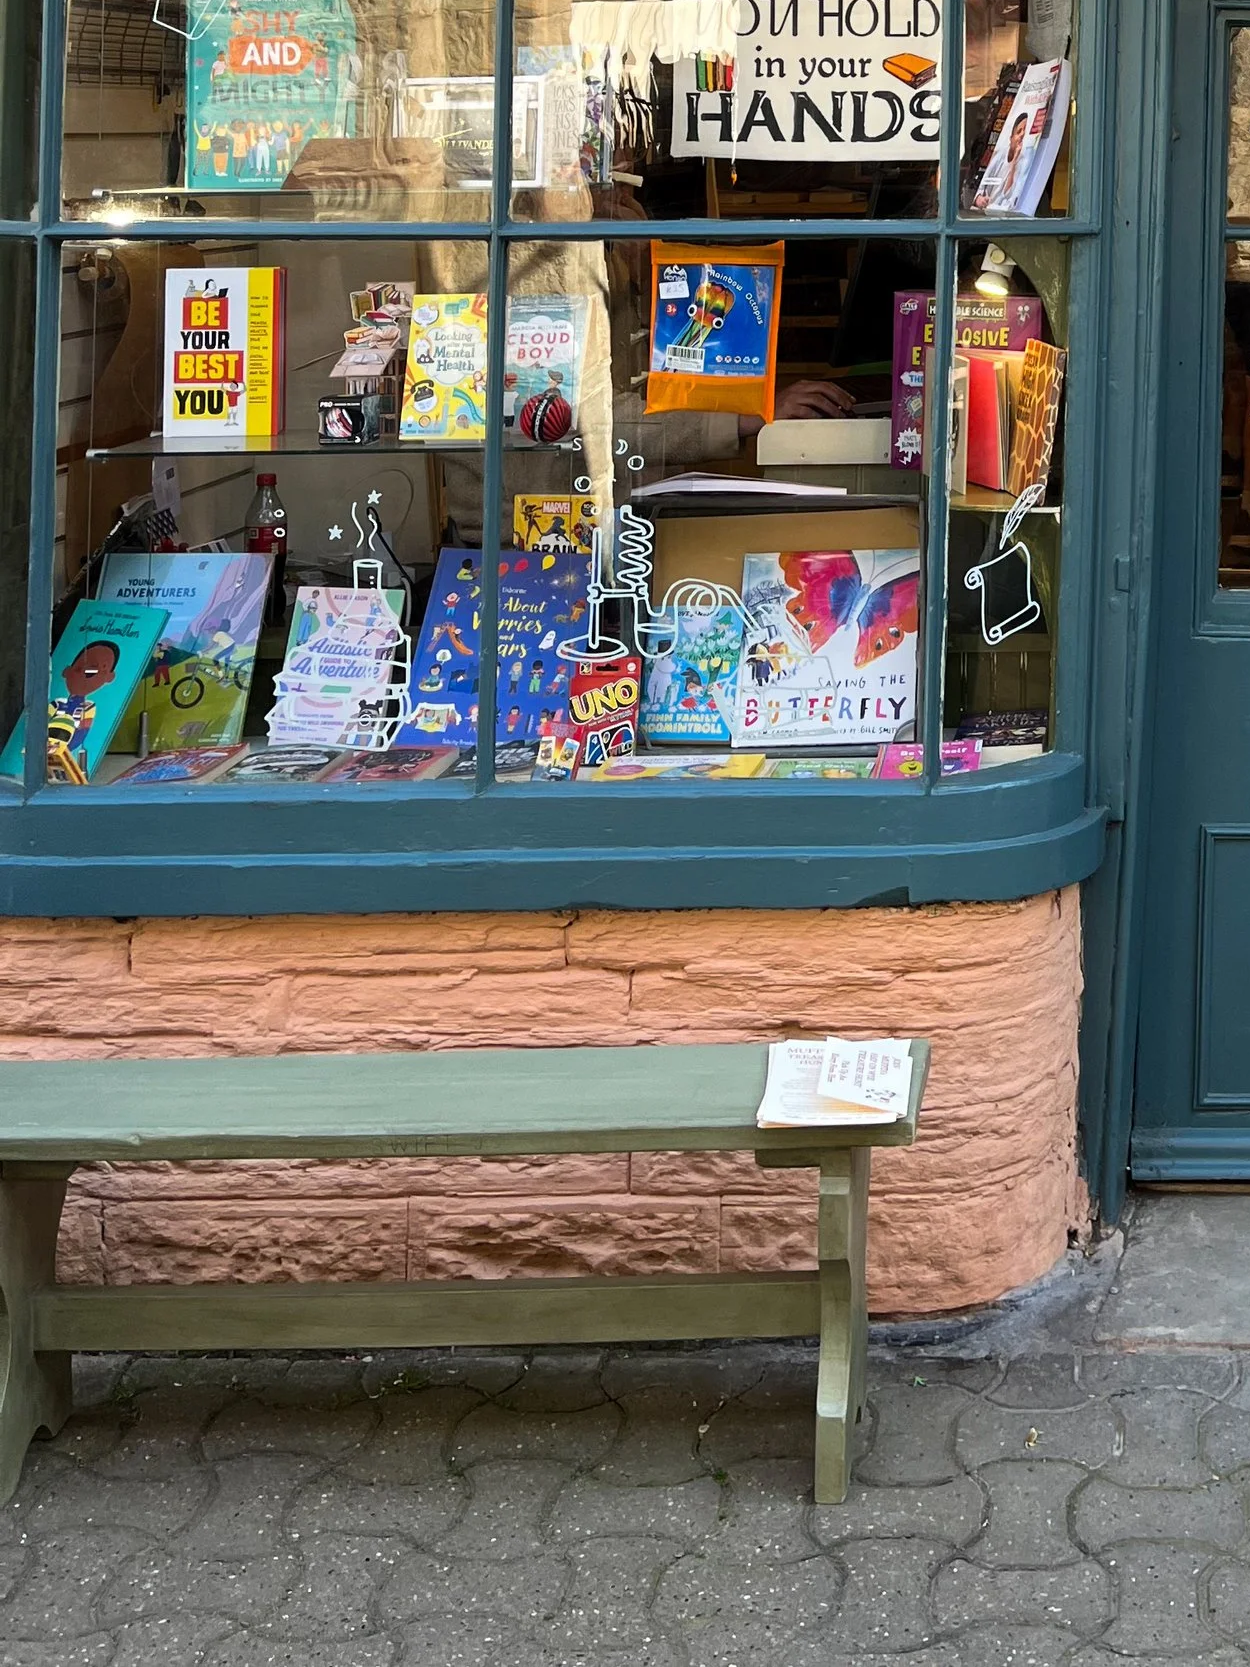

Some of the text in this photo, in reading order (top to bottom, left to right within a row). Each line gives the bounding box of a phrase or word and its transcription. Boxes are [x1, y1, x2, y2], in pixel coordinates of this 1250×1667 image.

[243, 10, 299, 33] SHY
[241, 41, 302, 66] AND
[754, 45, 873, 85] in your
[211, 77, 330, 105] MIGHTY
[685, 89, 942, 143] HANDS
[190, 300, 221, 327] BE
[745, 291, 764, 325] Octopus
[972, 303, 1004, 318] SCIENCE
[179, 330, 230, 350] YOUR
[434, 331, 473, 343] Looking
[507, 332, 570, 346] CLOUD
[433, 346, 475, 359] Mental
[517, 346, 554, 360] BOY
[178, 353, 239, 380] BEST
[436, 360, 475, 372] Health
[174, 389, 224, 416] YOU
[542, 501, 571, 514] MARVEL
[532, 542, 578, 553] BRAIN
[127, 578, 156, 587] YOUNG
[116, 587, 197, 599] ADVENTURERS
[503, 596, 547, 614] About
[817, 674, 907, 690] SAVING THE
[570, 677, 639, 725] UNO
[645, 713, 674, 723] FINN
[675, 713, 721, 723] FAMILY
[744, 695, 907, 727] BUTTERFLY
